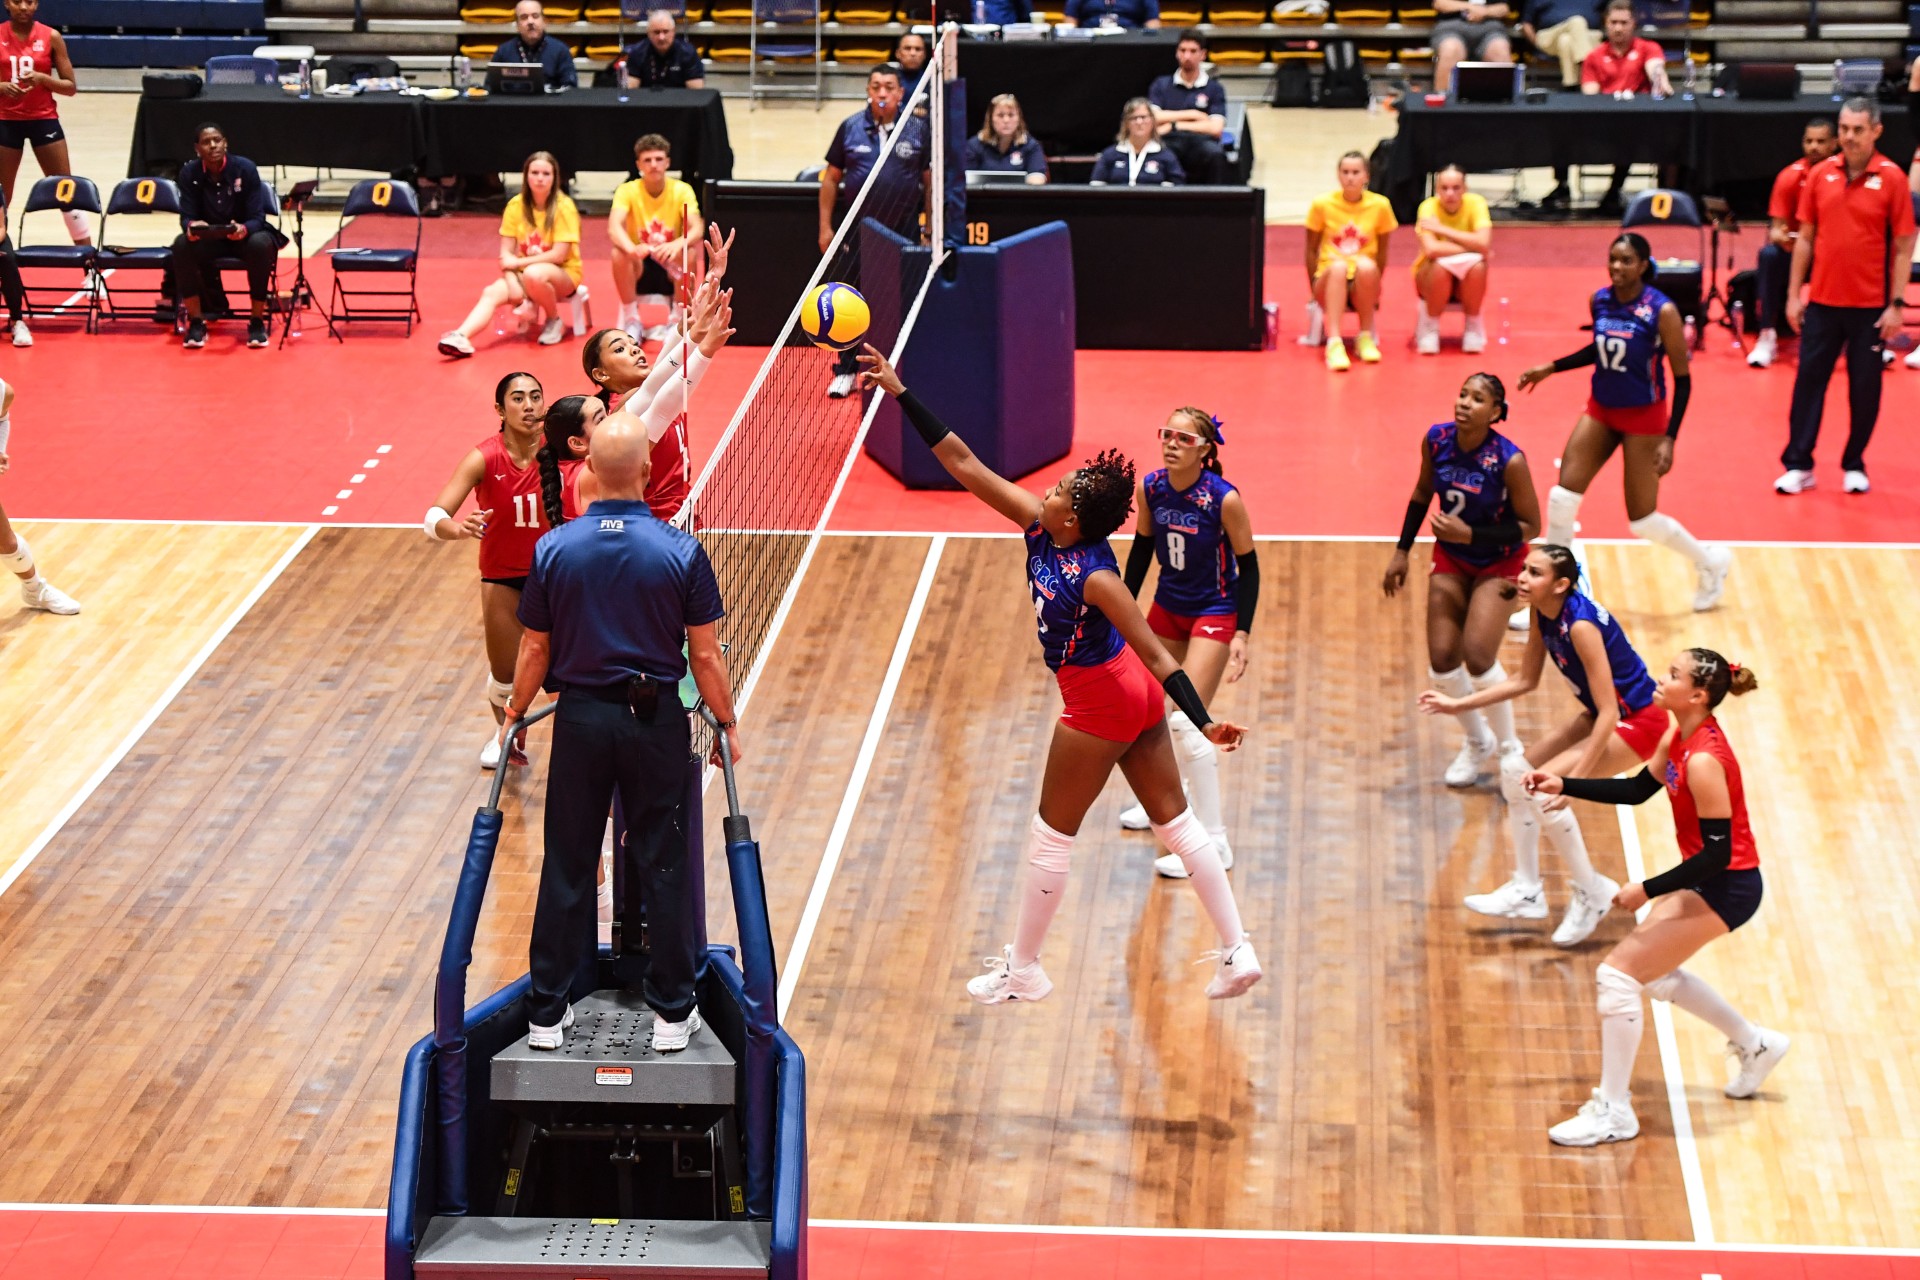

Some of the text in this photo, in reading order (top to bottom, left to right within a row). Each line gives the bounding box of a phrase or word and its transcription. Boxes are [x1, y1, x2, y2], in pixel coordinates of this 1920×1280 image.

[55, 179, 76, 203] Q
[136, 180, 157, 204] Q
[371, 182, 393, 206] Q
[966, 222, 989, 245] 19
[1595, 334, 1627, 372] 12
[513, 493, 540, 528] 11
[1446, 489, 1466, 516] 2
[1167, 532, 1185, 571] 8
